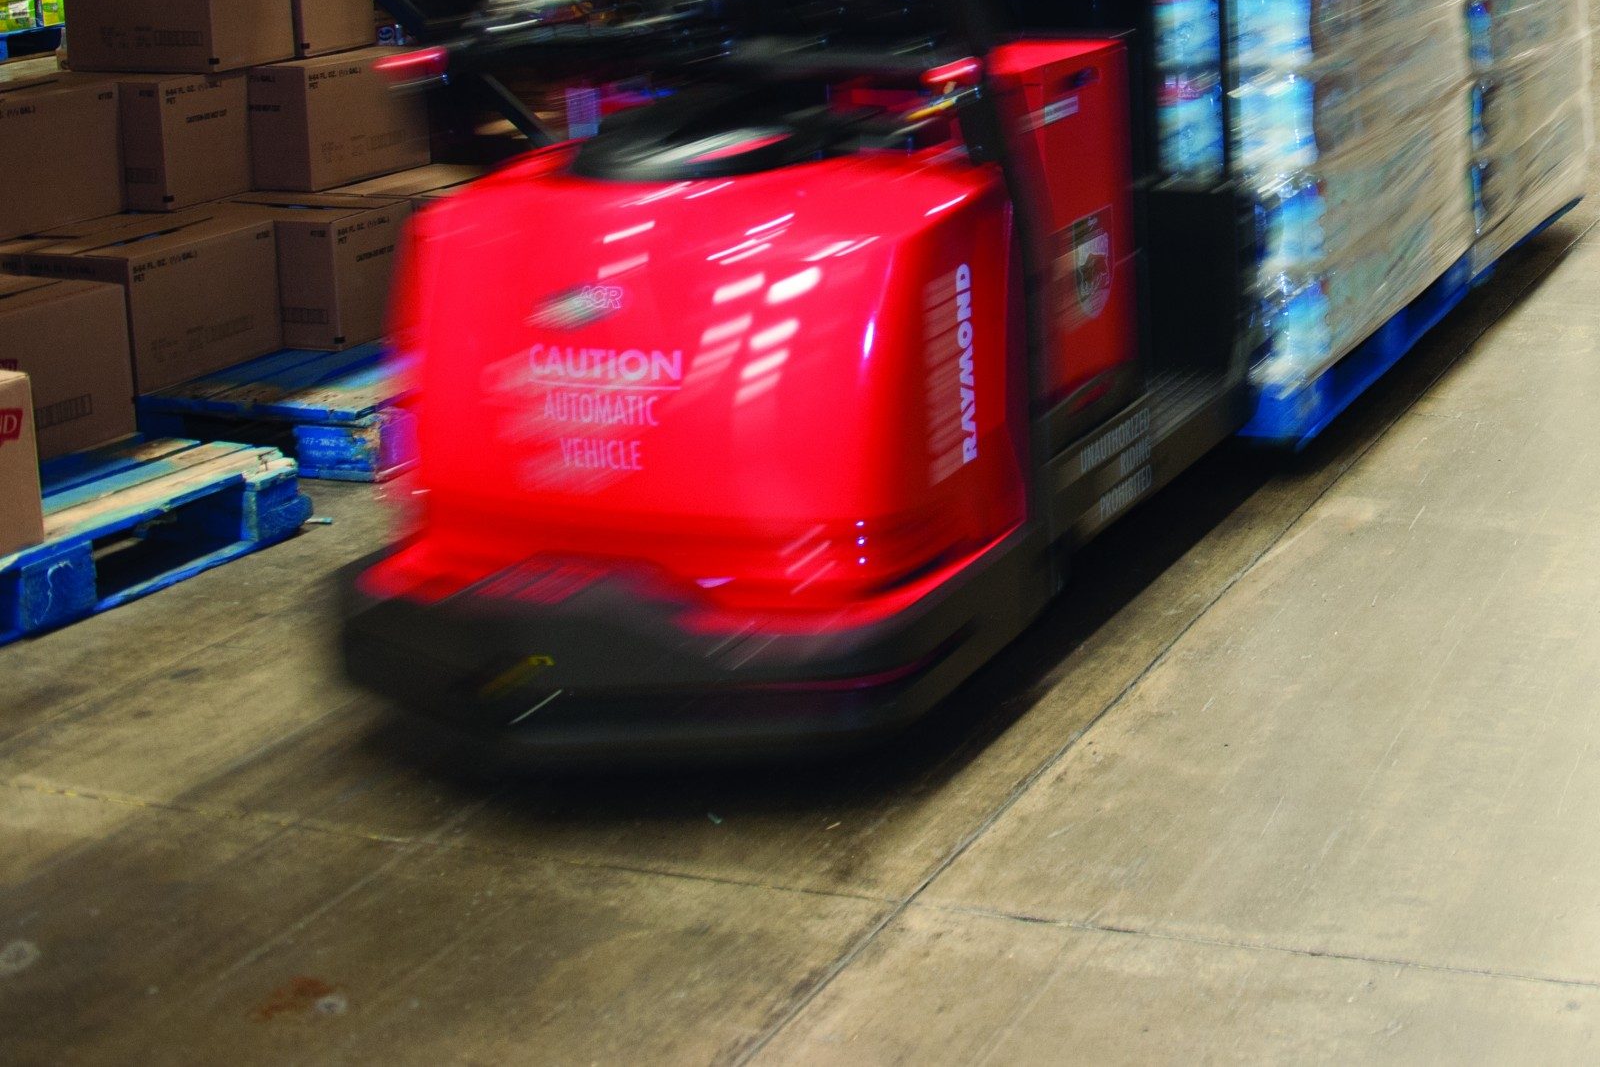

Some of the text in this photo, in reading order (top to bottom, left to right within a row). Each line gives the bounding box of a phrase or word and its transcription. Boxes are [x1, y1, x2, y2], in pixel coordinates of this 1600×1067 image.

[133, 273, 145, 282] PET
[528, 343, 683, 381] CAUTION
[955, 263, 978, 464] RAYMOND
[543, 391, 660, 427] AUTOMATIC
[559, 437, 644, 471] VEHICLE
[1080, 407, 1150, 473] UNAUTHORIZED
[1100, 464, 1152, 519] PROHIBITED
